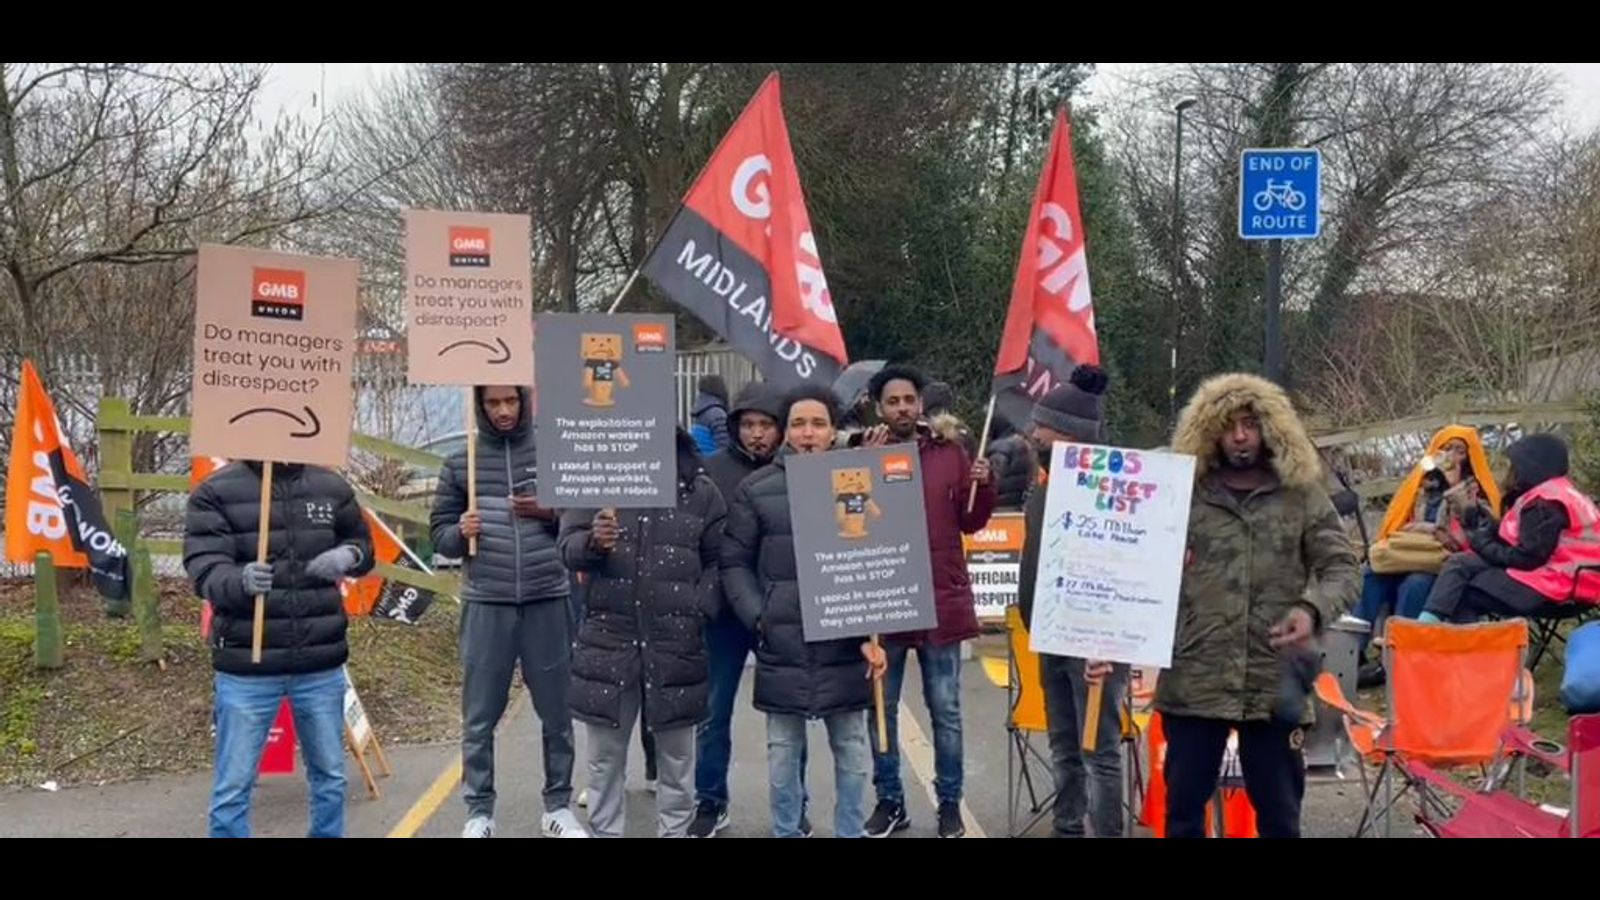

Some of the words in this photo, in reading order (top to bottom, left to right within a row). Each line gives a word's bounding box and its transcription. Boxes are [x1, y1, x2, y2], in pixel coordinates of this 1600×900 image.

[1249, 157, 1285, 171] END
[1291, 157, 1313, 171] OF
[1252, 215, 1307, 229] ROUTE
[453, 237, 486, 250] GMB
[258, 282, 299, 299] GMB
[414, 275, 436, 288] Do
[440, 276, 523, 293] managers
[414, 295, 453, 308] treat
[457, 298, 488, 310] you
[491, 296, 524, 309] with
[415, 313, 508, 329] disrespect?
[204, 324, 233, 340] Do
[238, 328, 343, 352] managers
[204, 348, 253, 366] treat
[258, 354, 295, 371] you
[300, 356, 341, 372] with
[202, 370, 319, 394] disrespect?
[556, 418, 575, 428] The
[578, 418, 642, 430] exploitation
[645, 418, 656, 428] of
[561, 430, 606, 440] Amazon
[608, 431, 650, 440] workers
[574, 442, 594, 452] has
[597, 442, 609, 452] to
[611, 442, 638, 452] STOP
[558, 461, 590, 471] stand
[592, 461, 602, 471] in
[605, 462, 647, 473] support
[649, 461, 661, 471] of
[1063, 445, 1143, 475] BEZOS
[561, 474, 606, 484] Amazon
[1076, 471, 1158, 499] BUCKET
[555, 486, 579, 497] they
[581, 487, 600, 496] are
[602, 486, 621, 496] not
[624, 486, 659, 496] robots
[1095, 493, 1142, 515] LIST
[814, 552, 834, 562] The
[836, 546, 897, 559] exploitation
[899, 542, 910, 553] of
[820, 562, 864, 574] Amazon
[865, 556, 906, 569] workers
[834, 574, 854, 584] has
[856, 572, 867, 582] to
[869, 569, 895, 580] STOP
[820, 594, 852, 604] stand
[853, 590, 863, 600] in
[865, 586, 906, 600] support
[907, 583, 919, 594] of
[824, 604, 867, 616] Amazon
[819, 617, 843, 628] they
[845, 615, 864, 625] are
[865, 612, 883, 623] not
[885, 609, 919, 621] robots
